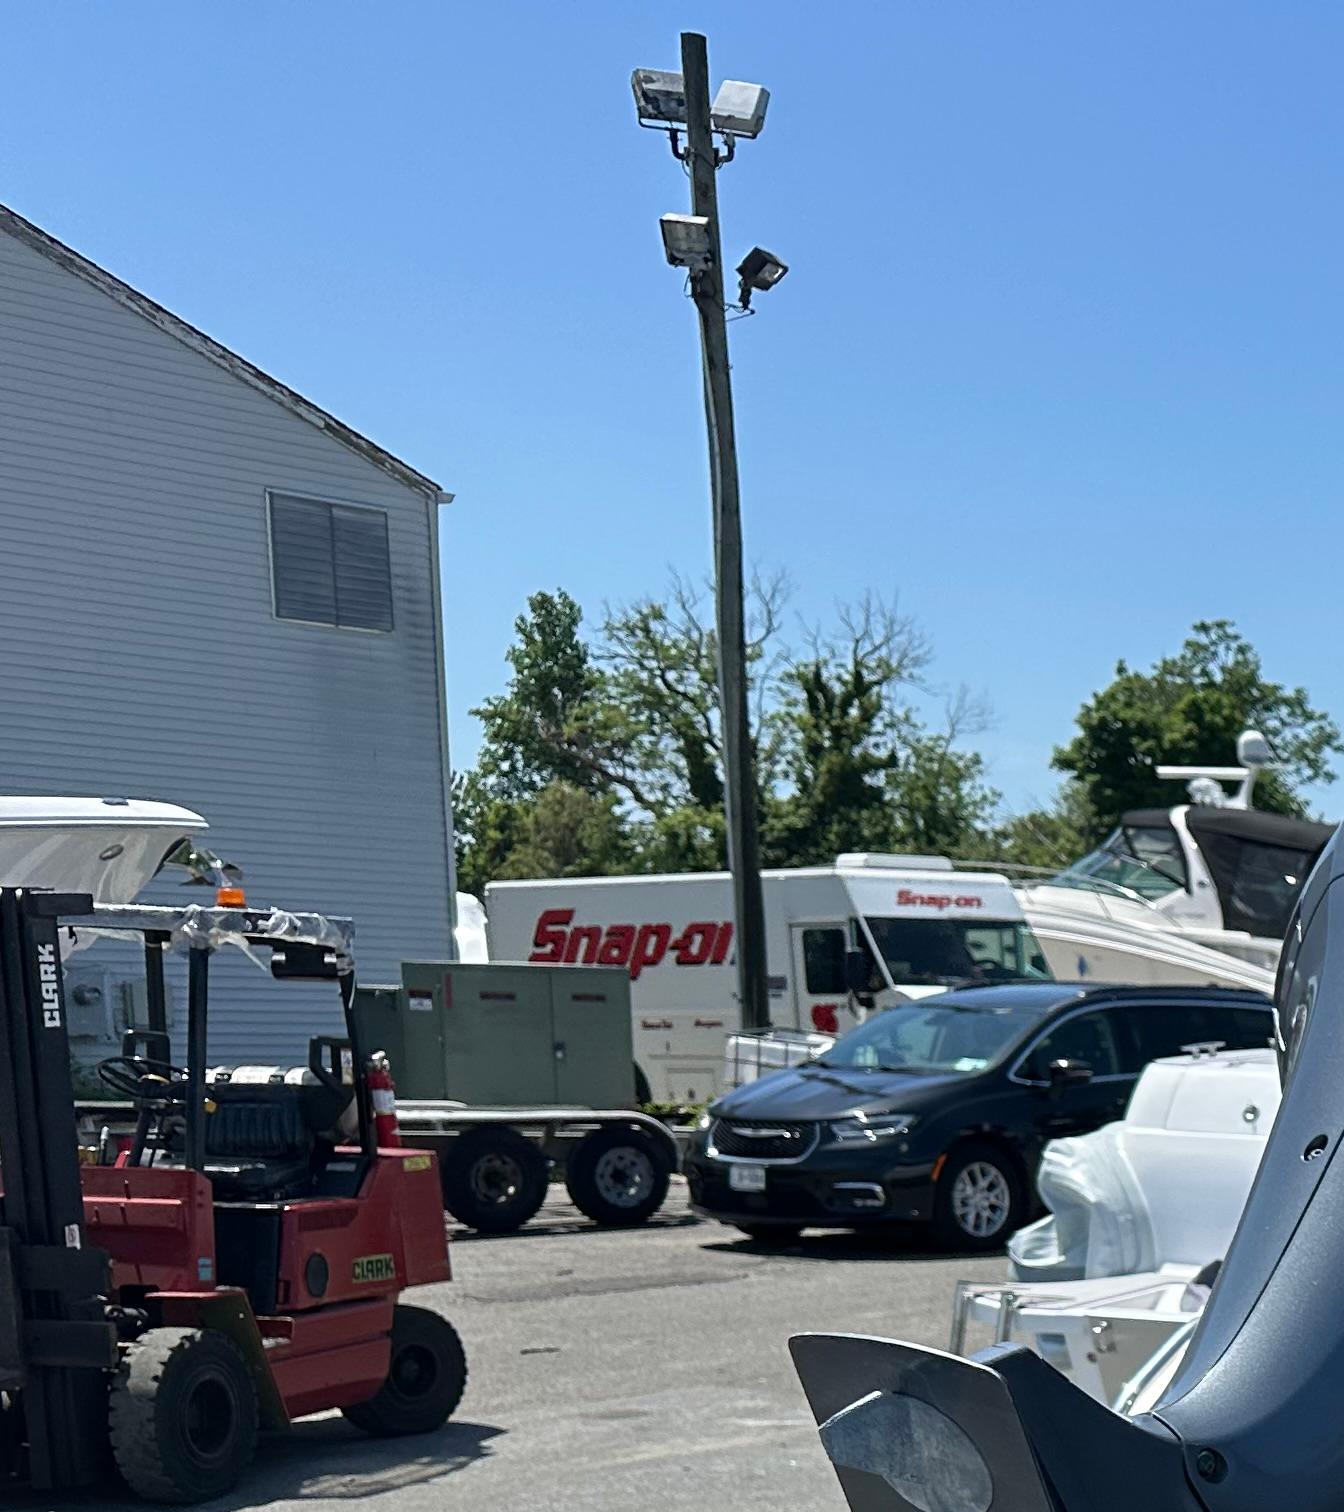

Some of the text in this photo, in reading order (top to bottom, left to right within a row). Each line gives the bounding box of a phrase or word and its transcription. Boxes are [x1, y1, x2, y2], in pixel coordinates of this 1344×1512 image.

[896, 888, 983, 911] Snap-on
[37, 943, 61, 1029] CLARK
[352, 1257, 395, 1280] CLARK
